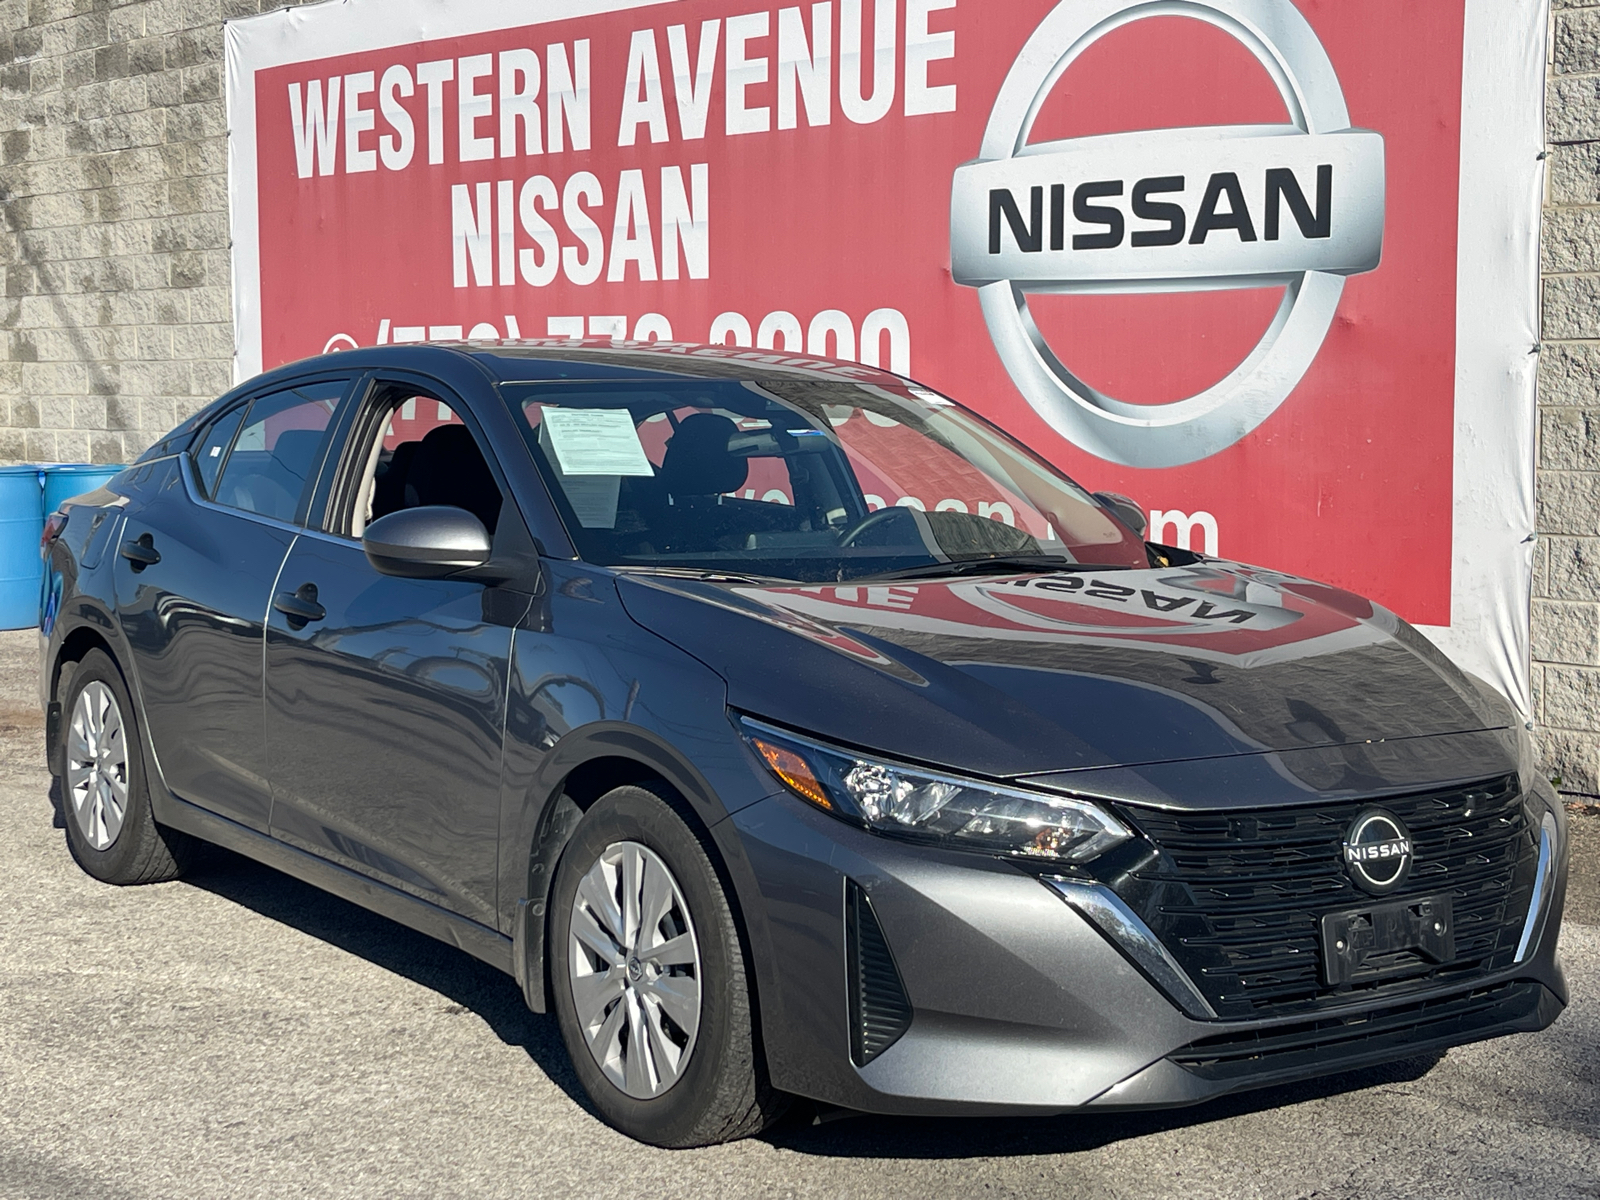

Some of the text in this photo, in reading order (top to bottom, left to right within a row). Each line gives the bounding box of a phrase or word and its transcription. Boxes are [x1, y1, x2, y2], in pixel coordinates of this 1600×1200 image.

[288, 0, 957, 179] WESTERN AVENUE
[451, 163, 710, 288] NISSAN
[988, 163, 1333, 254] NISSAN
[1348, 841, 1409, 860] NISSAN
